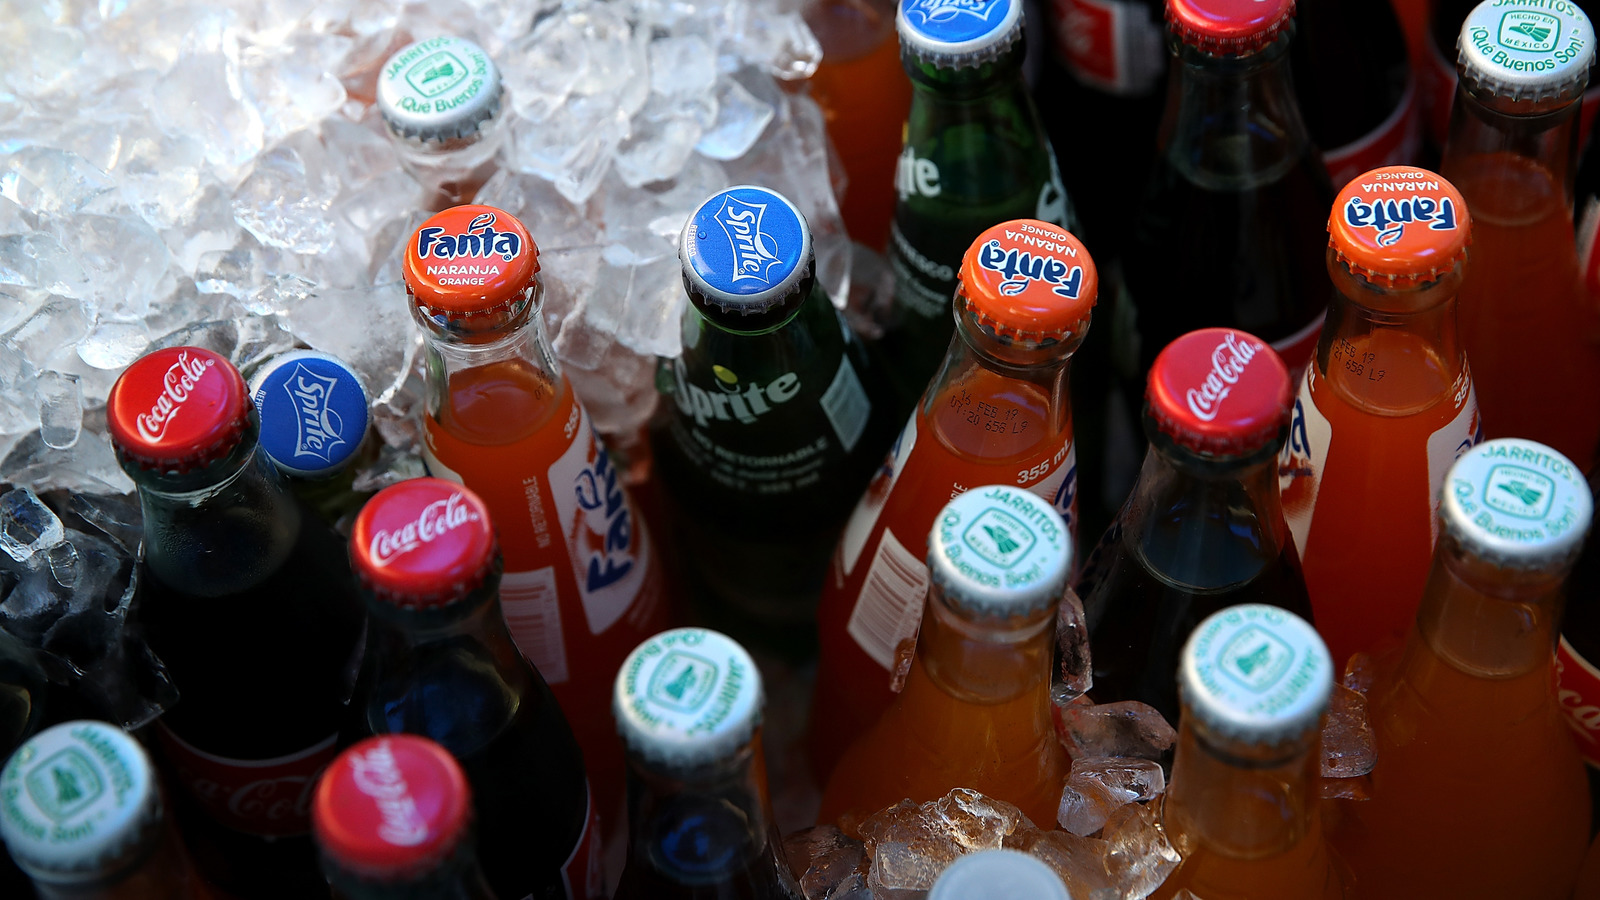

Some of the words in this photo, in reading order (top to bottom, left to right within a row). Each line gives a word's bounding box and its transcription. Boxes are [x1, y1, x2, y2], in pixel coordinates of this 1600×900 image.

[1510, 13, 1540, 21] HECHO
[1542, 17, 1555, 25] EN
[1491, 50, 1555, 72] Buenos
[435, 78, 484, 112] Buenos
[1361, 181, 1439, 193] NARANJA
[1375, 172, 1424, 181] ORANGE
[1344, 195, 1457, 231] Fanta
[418, 226, 522, 261] Fanta
[725, 205, 769, 272] Sprite
[1005, 228, 1078, 258] NARANJA
[1020, 223, 1067, 243] ORANGE
[426, 265, 500, 276] NARANJA
[438, 277, 486, 286] ORANGE
[977, 239, 1083, 299] Fanta
[294, 375, 332, 450] Sprite
[976, 401, 998, 418] FEB
[1016, 458, 1050, 484] 355
[1480, 445, 1574, 482] JARRITOS
[983, 486, 1062, 543] JARRITOS
